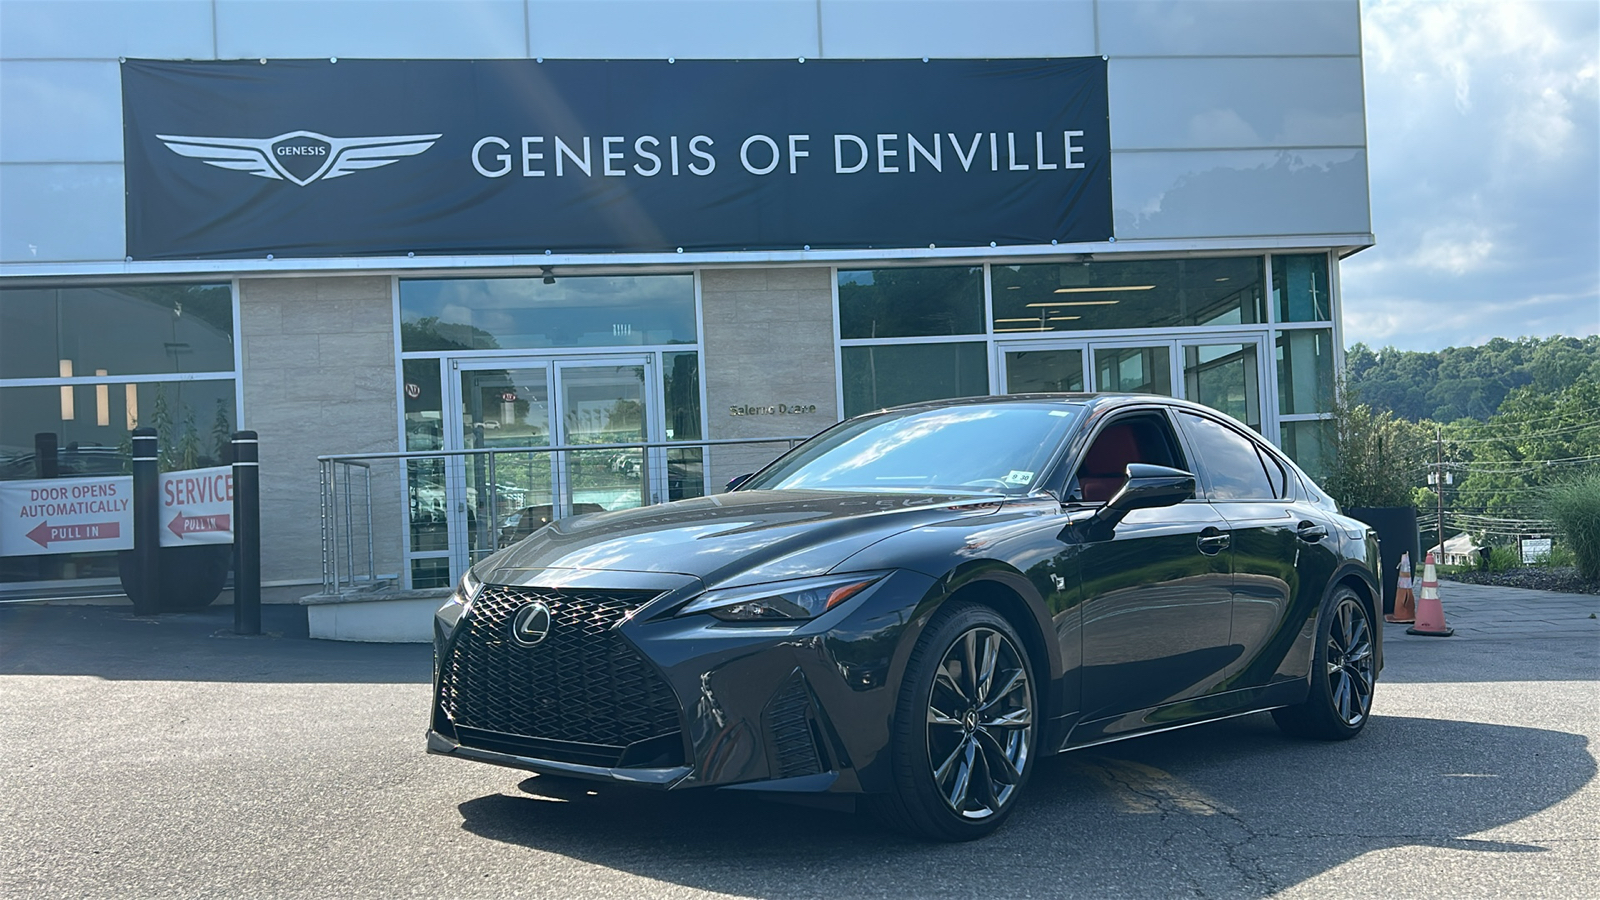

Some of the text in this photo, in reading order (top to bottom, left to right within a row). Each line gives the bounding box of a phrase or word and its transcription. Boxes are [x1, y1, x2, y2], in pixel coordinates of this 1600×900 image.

[277, 146, 326, 156] GENESIS
[471, 130, 1086, 178] GENESIS OF DENVILLE
[31, 483, 117, 502] DOOR OPENS
[164, 474, 233, 507] SERVICE
[20, 498, 129, 518] AUTOMATICALLY
[51, 525, 99, 540] PULL IN
[184, 517, 217, 531] PULL IN
